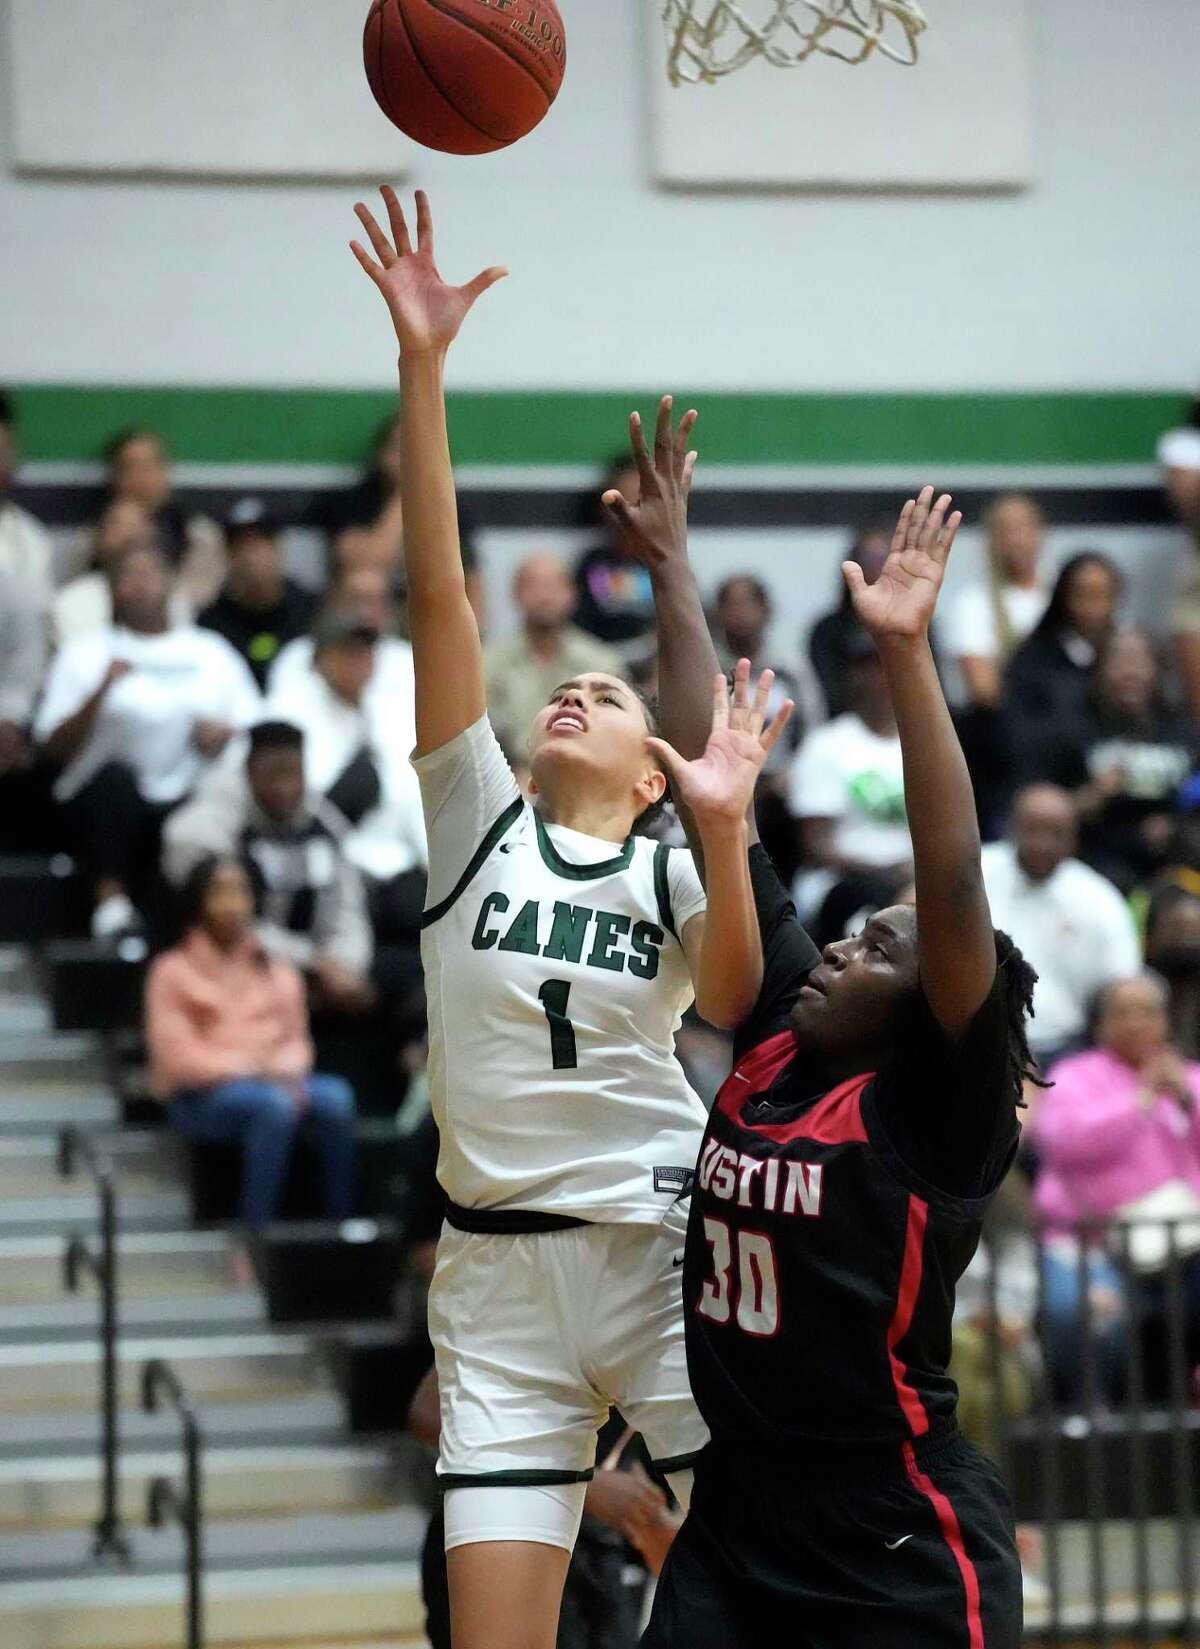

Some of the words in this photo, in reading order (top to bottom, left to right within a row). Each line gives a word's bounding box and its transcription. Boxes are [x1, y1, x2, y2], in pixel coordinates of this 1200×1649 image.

[472, 891, 665, 981] CANES
[538, 978, 578, 1069] 1
[695, 1215, 782, 1337] 30
